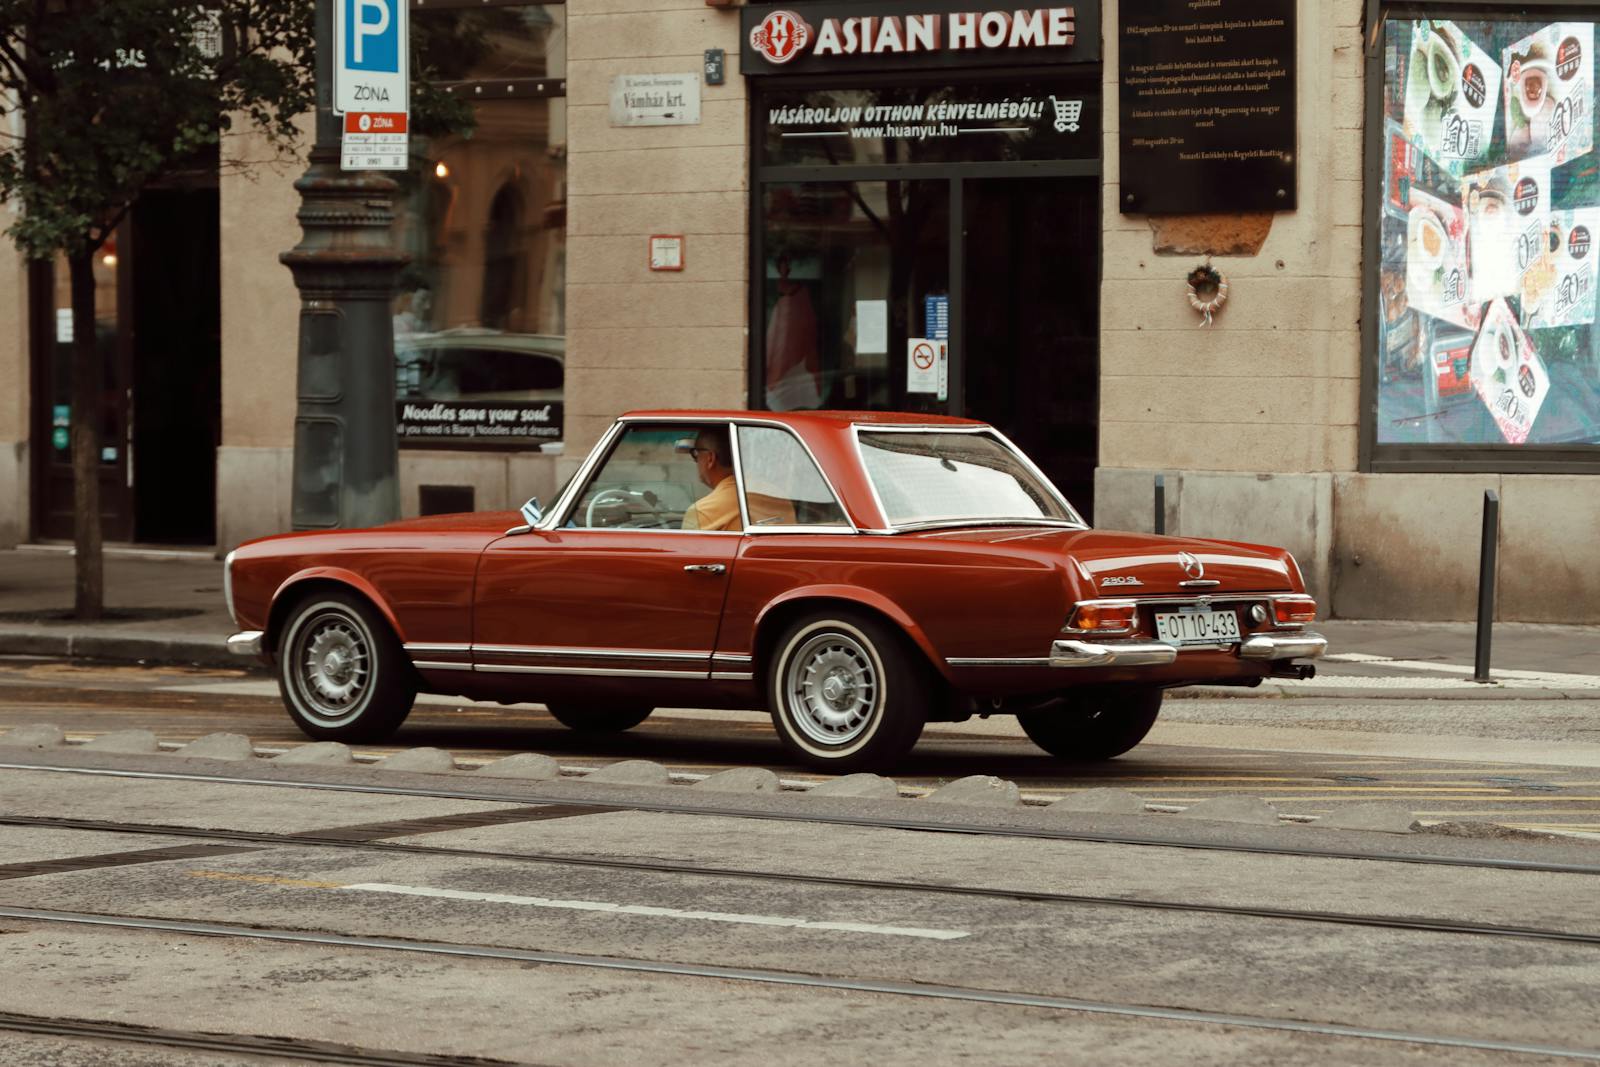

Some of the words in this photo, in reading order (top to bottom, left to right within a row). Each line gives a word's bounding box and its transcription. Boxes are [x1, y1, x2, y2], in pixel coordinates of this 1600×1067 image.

[353, 0, 391, 63] P
[812, 15, 939, 55] ASIAN
[948, 8, 1073, 50] HOME
[353, 82, 390, 102] ZÓNA
[623, 92, 665, 108] Vámház
[666, 90, 687, 107] krt.
[768, 105, 861, 125] VÁSÁROLJON
[863, 104, 925, 123] OTTHON
[926, 97, 1045, 121] KÉNYELMÉBŐL!
[850, 122, 958, 141] www.huanyu.hu
[402, 403, 457, 421] Noodles
[458, 408, 487, 421] save
[488, 408, 519, 425] your
[520, 405, 551, 421] soul
[1169, 615, 1186, 638] OT
[1190, 613, 1236, 637] 10-433
